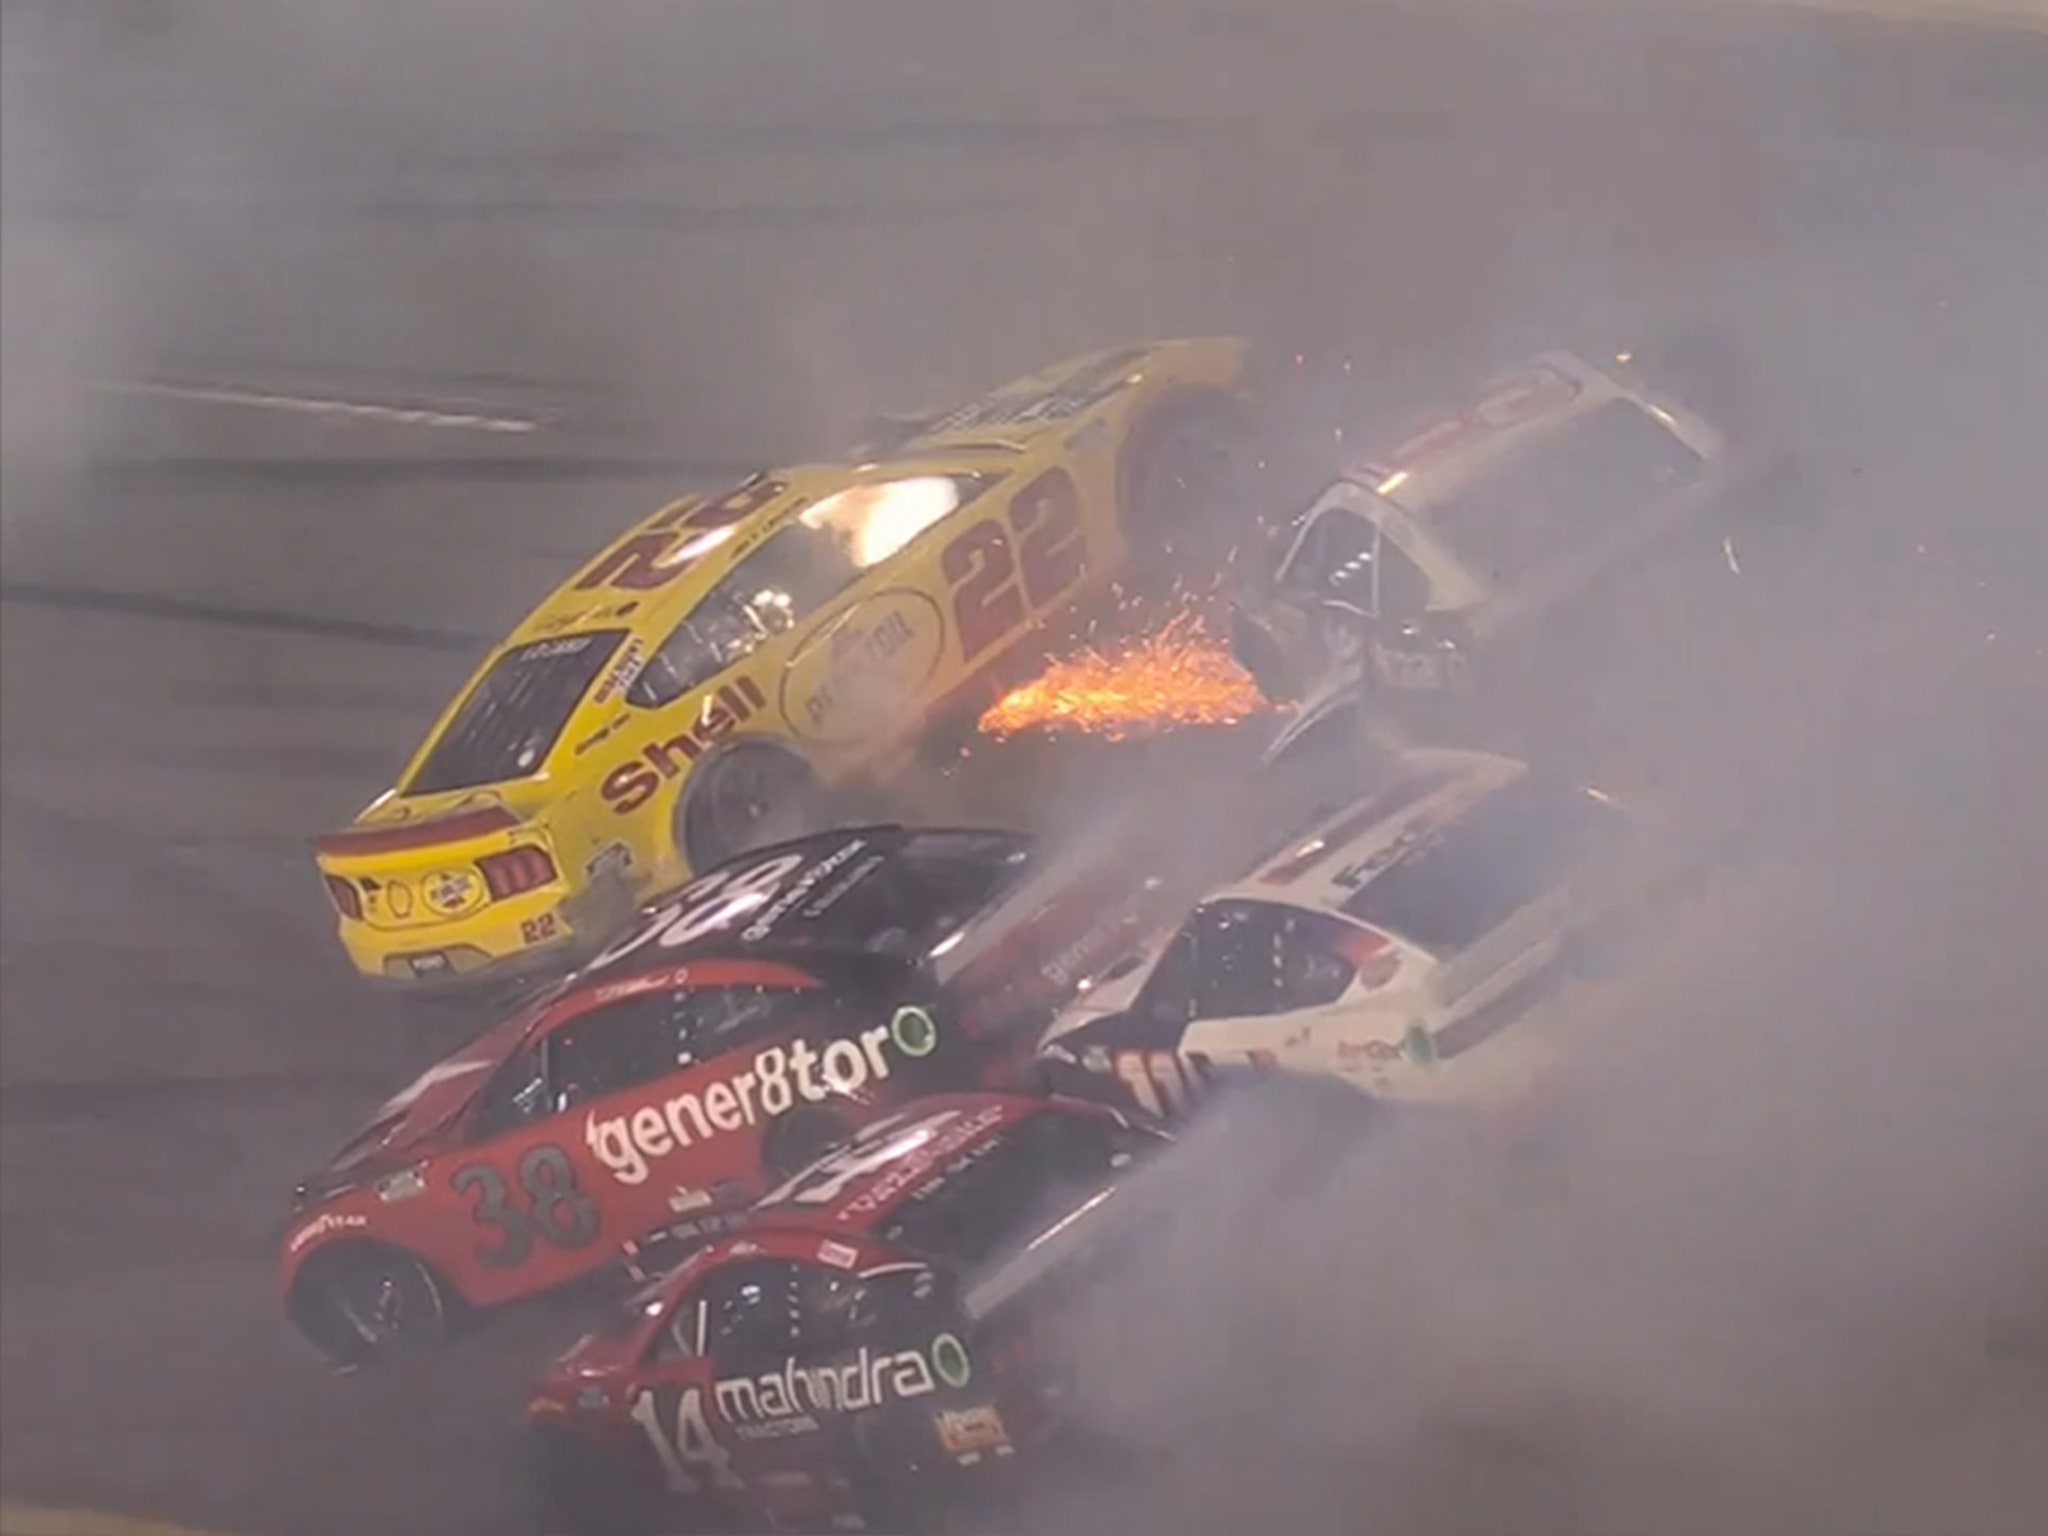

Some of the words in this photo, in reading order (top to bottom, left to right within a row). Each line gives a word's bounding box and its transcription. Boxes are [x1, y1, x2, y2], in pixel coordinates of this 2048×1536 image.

[941, 466, 1087, 664] 22
[601, 676, 767, 815] Shell
[521, 913, 557, 944] 22
[586, 1025, 890, 1185] gener8tor
[452, 1143, 598, 1270] 38
[630, 1387, 746, 1494] 14
[714, 1348, 936, 1423] mahindra
